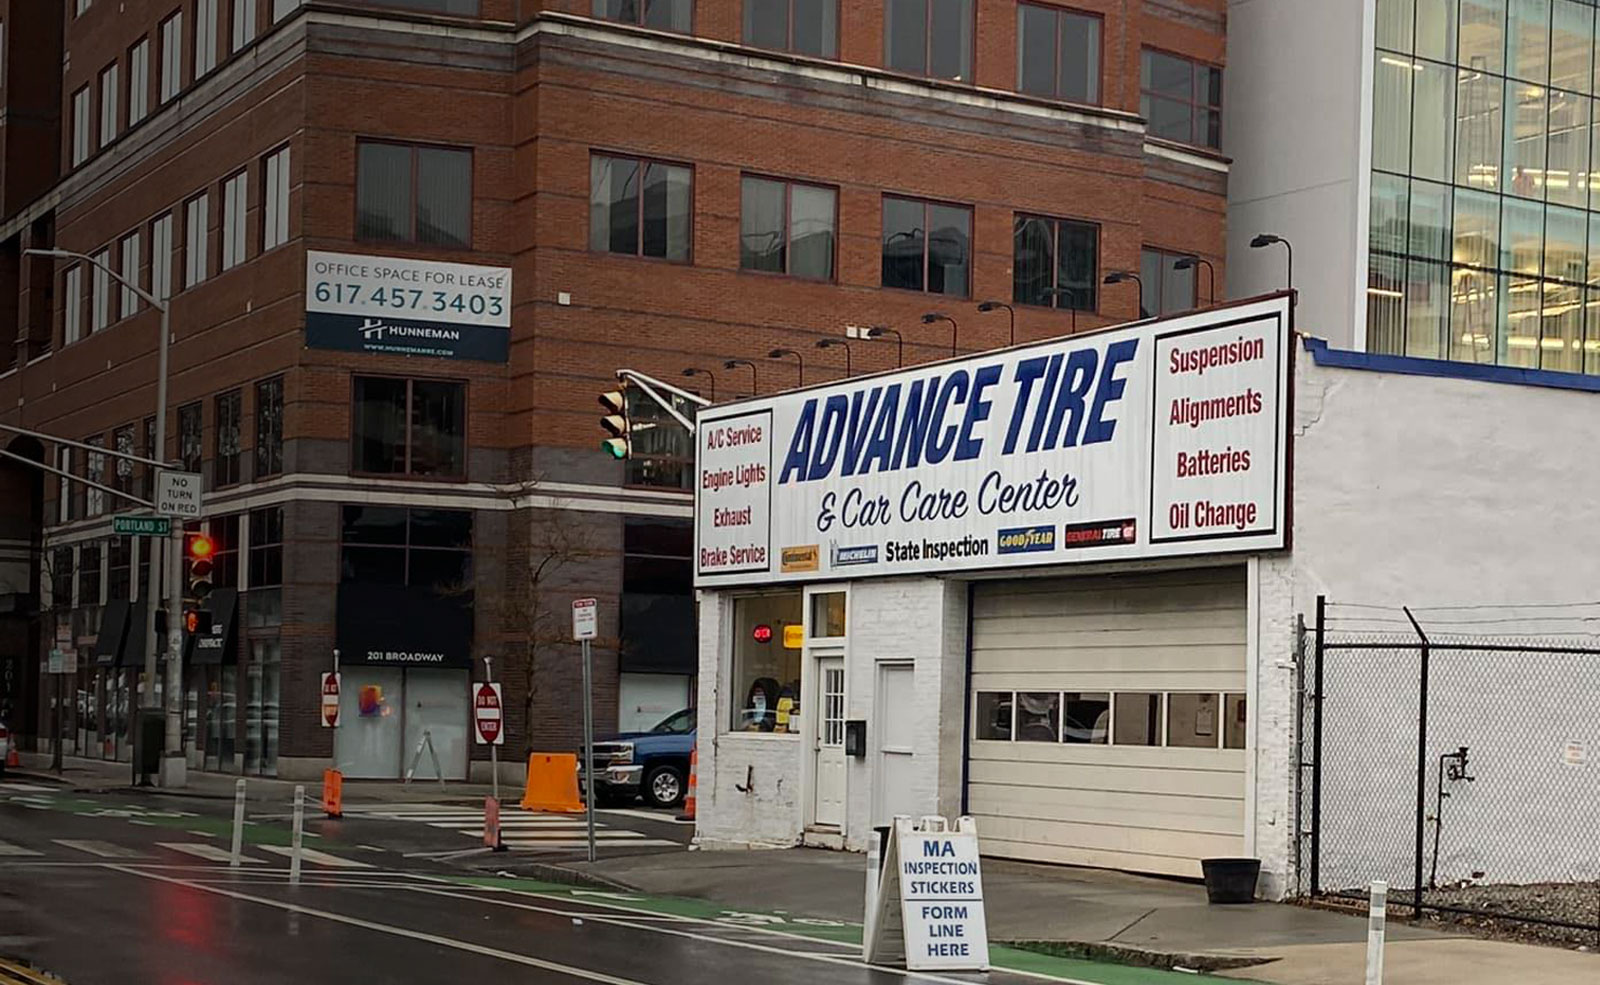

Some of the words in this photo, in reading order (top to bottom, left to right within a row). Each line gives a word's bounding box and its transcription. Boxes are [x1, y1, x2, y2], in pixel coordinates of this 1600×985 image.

[315, 262, 368, 277] OFFICE
[373, 267, 420, 282] SPACE
[425, 271, 455, 285] FOR
[460, 275, 504, 289] LEASE
[315, 282, 503, 316] 617.457.3403
[389, 326, 460, 340] HUNNEMAN
[1169, 336, 1264, 376] Suspension
[778, 364, 1004, 485] ADVANCE
[1001, 338, 1140, 456] TIRE
[1169, 388, 1263, 428] Alignments
[707, 428, 725, 450] A/C
[726, 424, 763, 447] Service
[1176, 446, 1251, 478] Batteries
[172, 478, 188, 487] NO
[702, 468, 734, 493] Engine
[735, 463, 766, 490] Lights
[167, 489, 193, 500] TURN
[817, 491, 836, 532] &
[842, 487, 892, 528] Car
[899, 480, 969, 522] Care
[978, 468, 1079, 515] Center
[161, 503, 175, 513] ON
[177, 503, 197, 514] RED
[713, 505, 752, 528] Exhaust
[1169, 505, 1189, 530] Oil
[1195, 501, 1257, 530] Change
[115, 519, 155, 532] PORTLAND
[158, 521, 168, 533] ST
[700, 547, 728, 568] Brake
[729, 543, 766, 565] Service
[886, 540, 920, 563] State
[923, 535, 989, 562] Inspection
[367, 651, 383, 661] 201
[385, 651, 445, 663] BROADWAY
[923, 840, 956, 857] MA
[904, 862, 978, 875] INSPECTION
[910, 881, 975, 894] STICKERS
[922, 906, 968, 919] FORM
[929, 924, 964, 938] LINE
[927, 943, 970, 957] HERE
